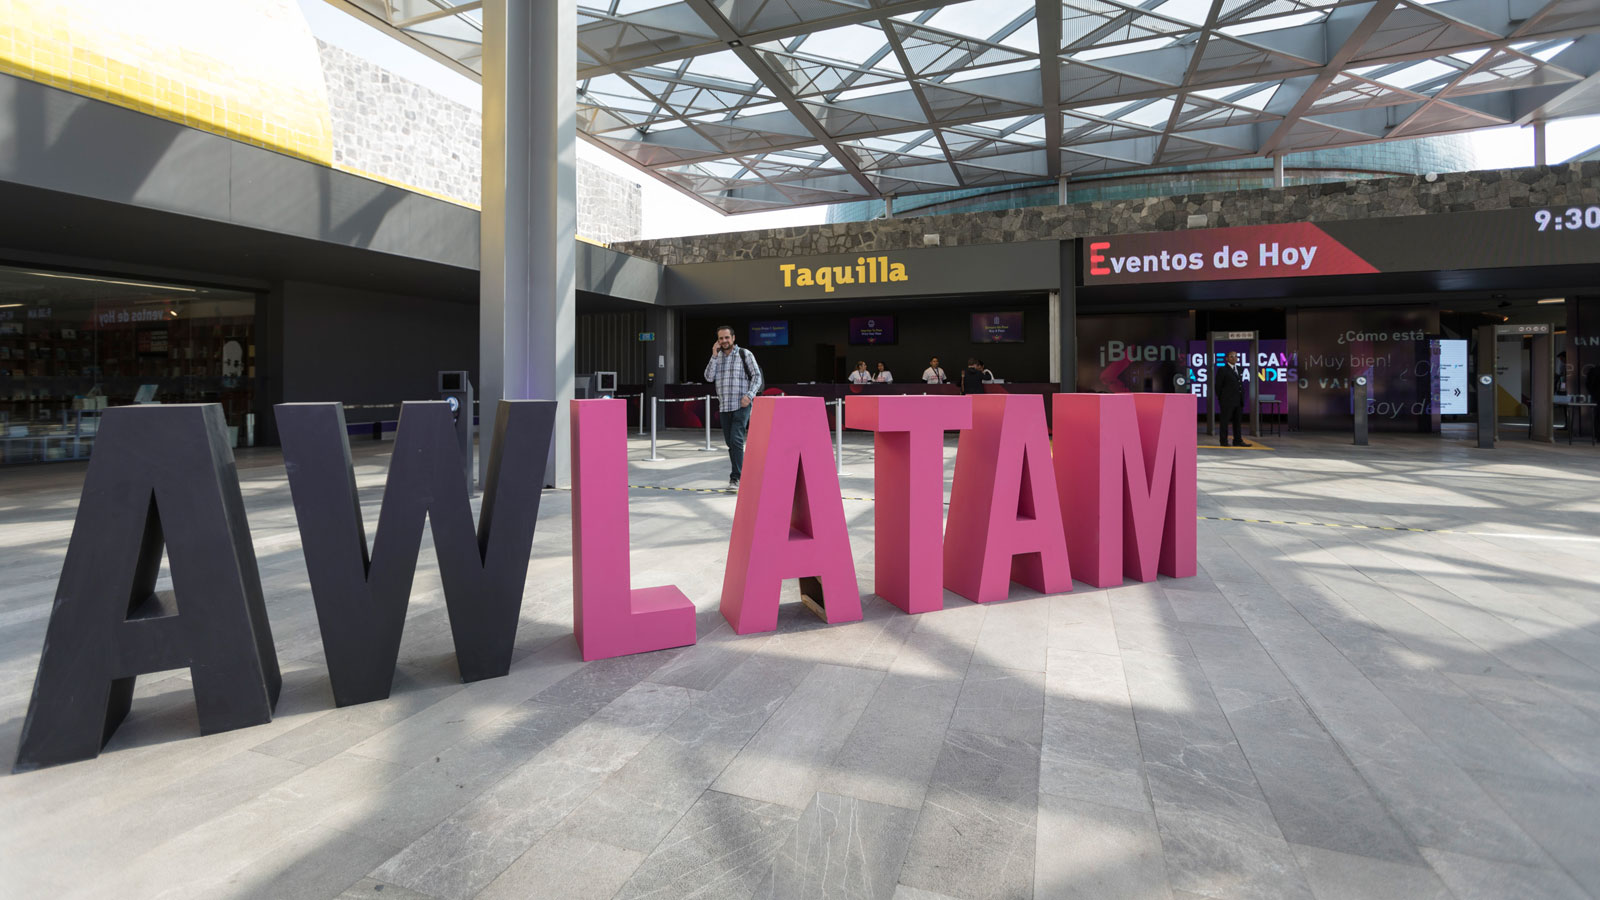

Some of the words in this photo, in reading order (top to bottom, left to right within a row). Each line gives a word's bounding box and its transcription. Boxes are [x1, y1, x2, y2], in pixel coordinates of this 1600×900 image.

[1534, 206, 1600, 231] 9:30
[1090, 241, 1204, 276] Eventos
[1213, 245, 1248, 269] de
[1259, 242, 1317, 270] Hoy
[779, 256, 909, 292] Taquilla
[1337, 330, 1389, 345] ¿Cómo
[1099, 340, 1183, 367] ¡Buen
[1304, 353, 1344, 371] ¡Muy
[1350, 353, 1392, 368] bien!
